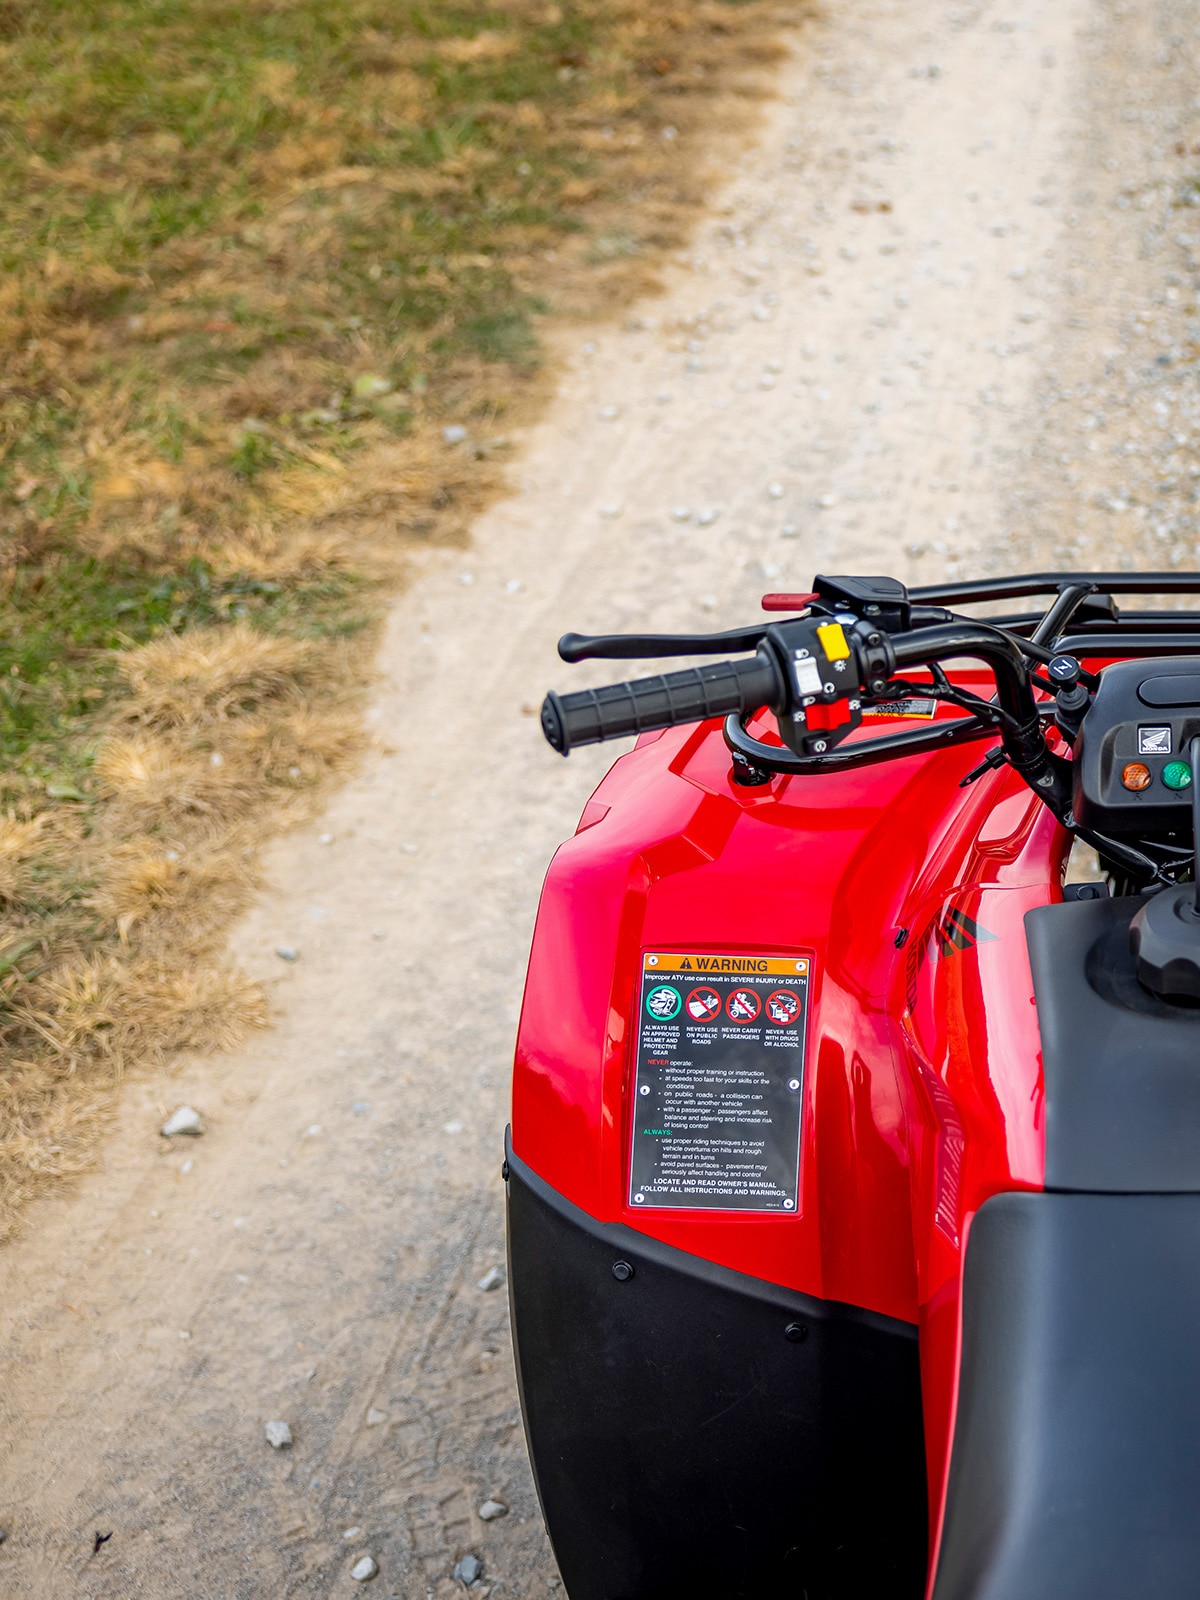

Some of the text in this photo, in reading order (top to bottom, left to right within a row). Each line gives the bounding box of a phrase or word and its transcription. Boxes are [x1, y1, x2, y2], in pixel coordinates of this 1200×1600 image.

[696, 958, 768, 972] WARNING
[645, 974, 670, 982] Improper
[700, 1115, 723, 1123] steering
[710, 1139, 741, 1147] techniques
[704, 1170, 729, 1178] handling
